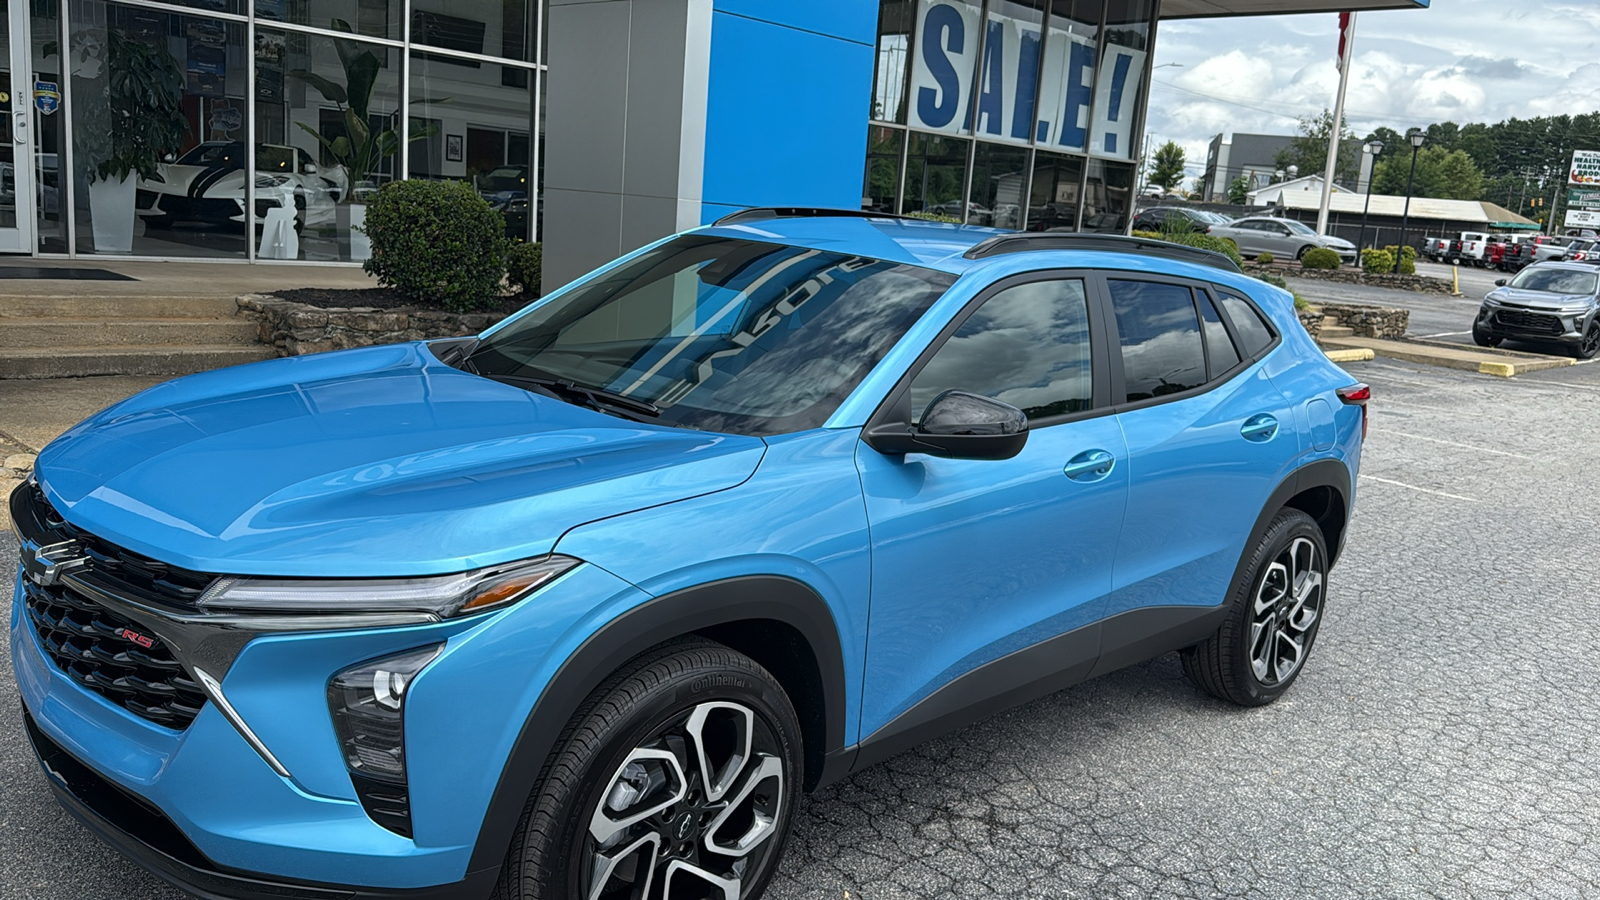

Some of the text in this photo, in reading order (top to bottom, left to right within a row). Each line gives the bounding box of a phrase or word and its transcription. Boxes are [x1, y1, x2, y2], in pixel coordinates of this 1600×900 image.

[917, 3, 1133, 154] SALE!
[122, 629, 154, 648] RS
[690, 673, 746, 693] Continental
